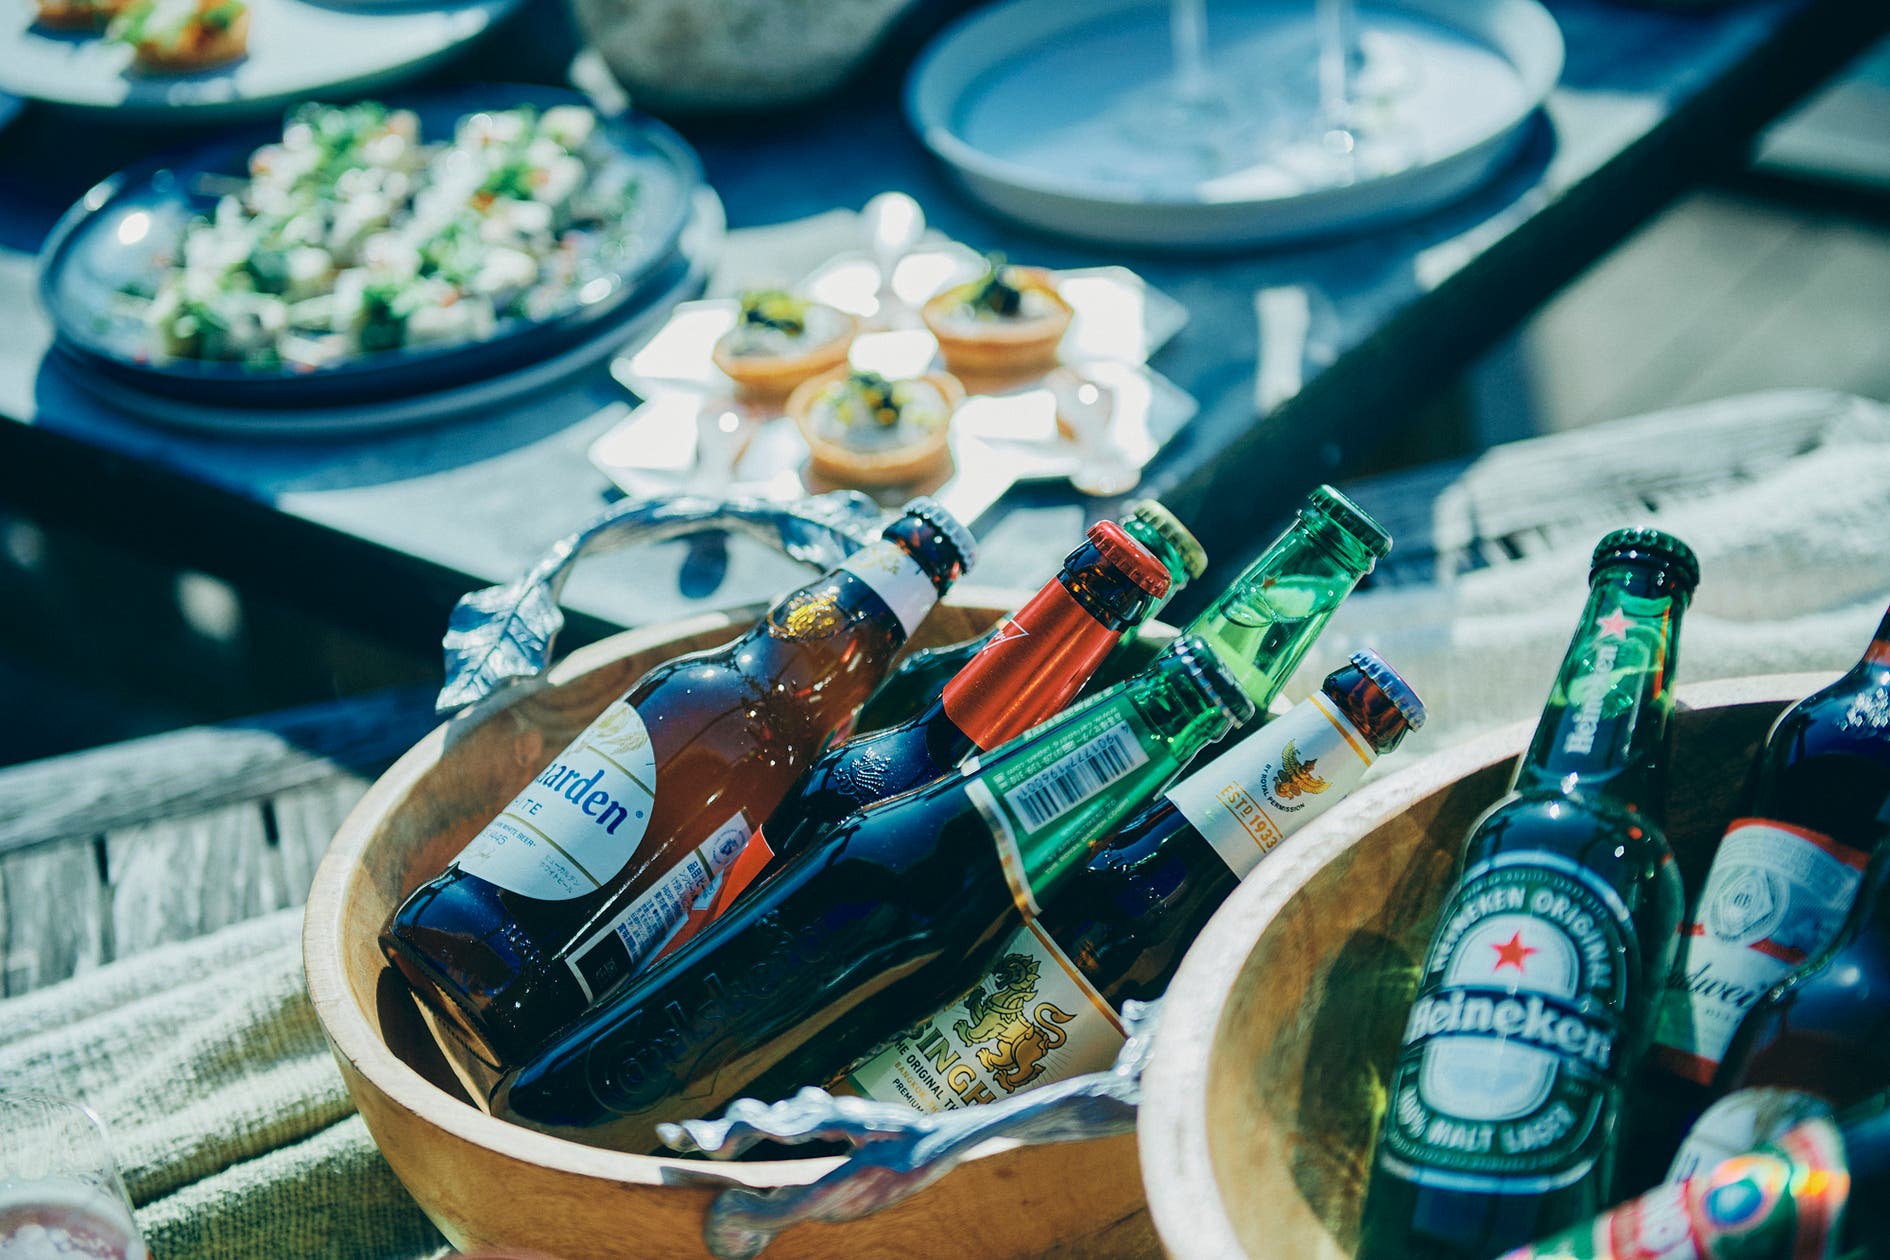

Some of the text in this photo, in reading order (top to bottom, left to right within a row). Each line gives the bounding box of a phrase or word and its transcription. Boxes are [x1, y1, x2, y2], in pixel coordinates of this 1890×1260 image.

[1120, 723, 1129, 735] 4
[1069, 733, 1115, 767] 901777
[1020, 763, 1066, 797] 196001
[1260, 763, 1305, 813] BY ROYAL PERMISSION
[515, 798, 543, 816] ITE
[1249, 814, 1278, 849] 1933
[1402, 989, 1611, 1070] Heineken
[895, 1041, 909, 1055] HE
[906, 1054, 945, 1100] ORIGINAL
[944, 1098, 959, 1111] TH
[908, 1020, 997, 1107] SINGH
